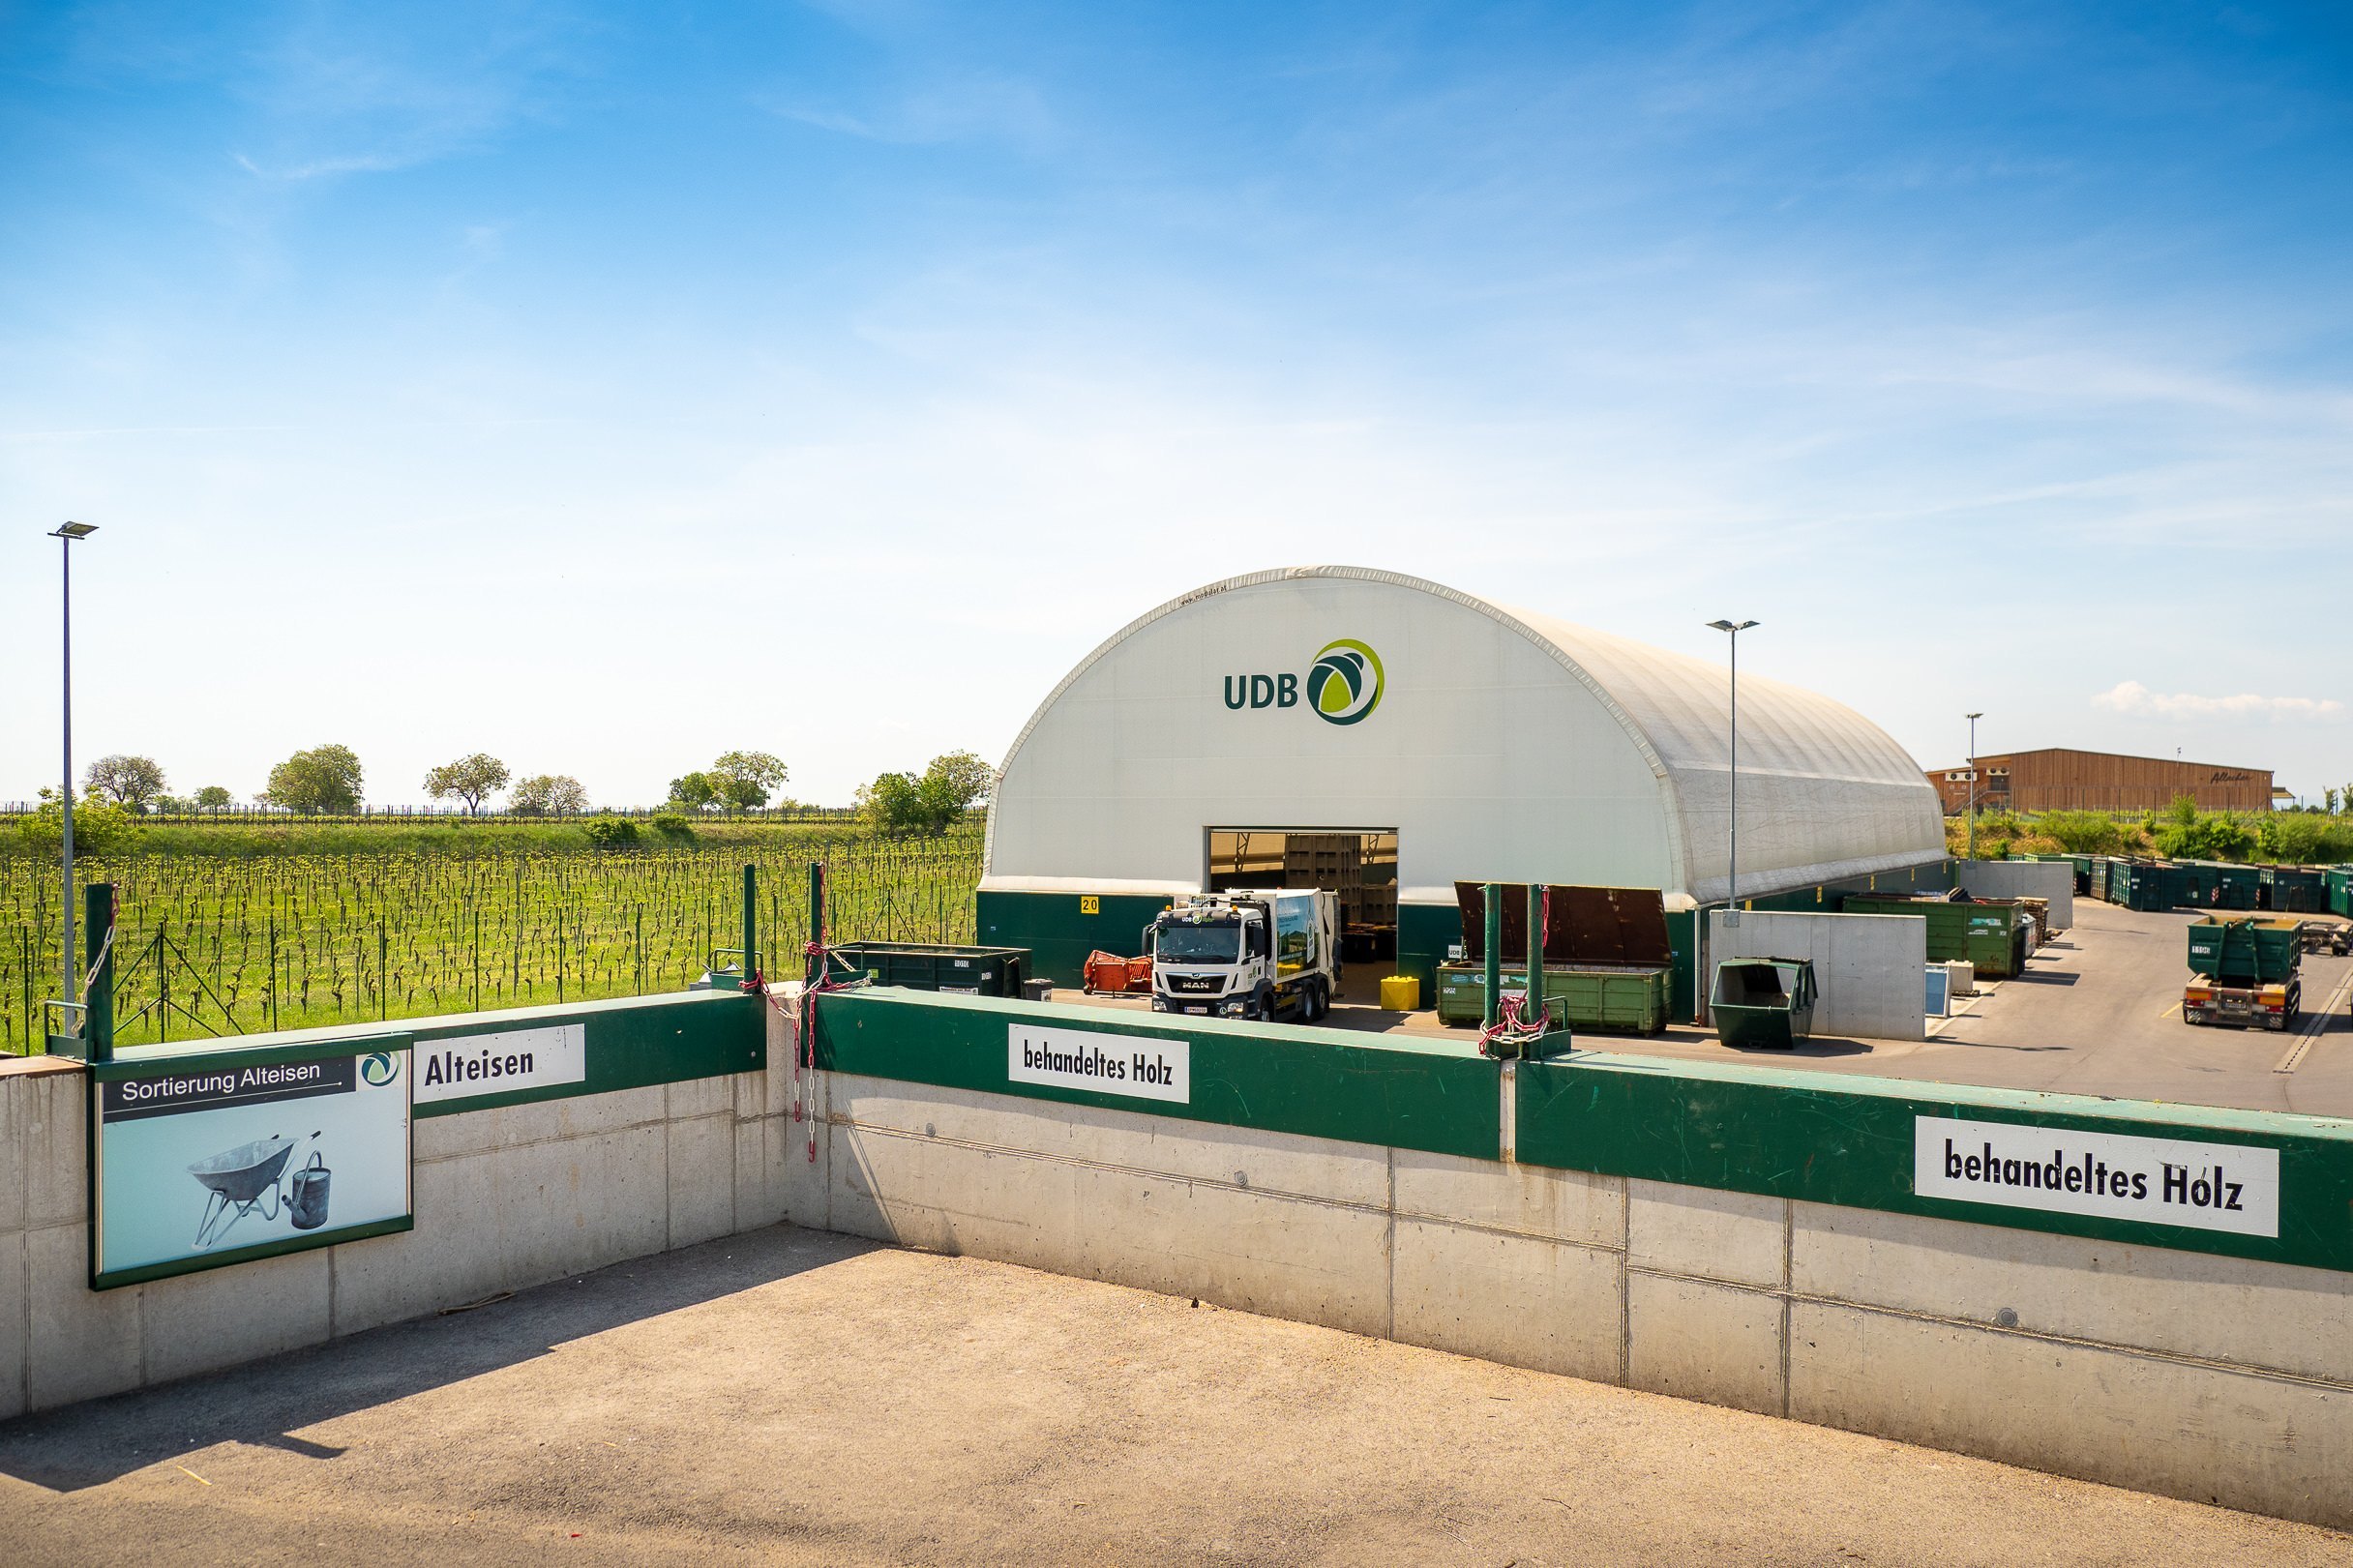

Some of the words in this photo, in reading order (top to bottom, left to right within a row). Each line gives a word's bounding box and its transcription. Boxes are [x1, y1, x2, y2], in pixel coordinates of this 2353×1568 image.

[1180, 584, 1227, 606] www.modular.at
[1224, 673, 1298, 710] UDB
[1083, 900, 1097, 910] 20
[424, 1049, 534, 1086] Alteisen
[1024, 1039, 1125, 1080] behandeltes
[1133, 1053, 1173, 1086] Holz
[121, 1074, 235, 1101] Sortierung
[240, 1062, 321, 1086] Alteisen
[1945, 1138, 2148, 1199] behandeltes
[2162, 1164, 2244, 1211] Holz
